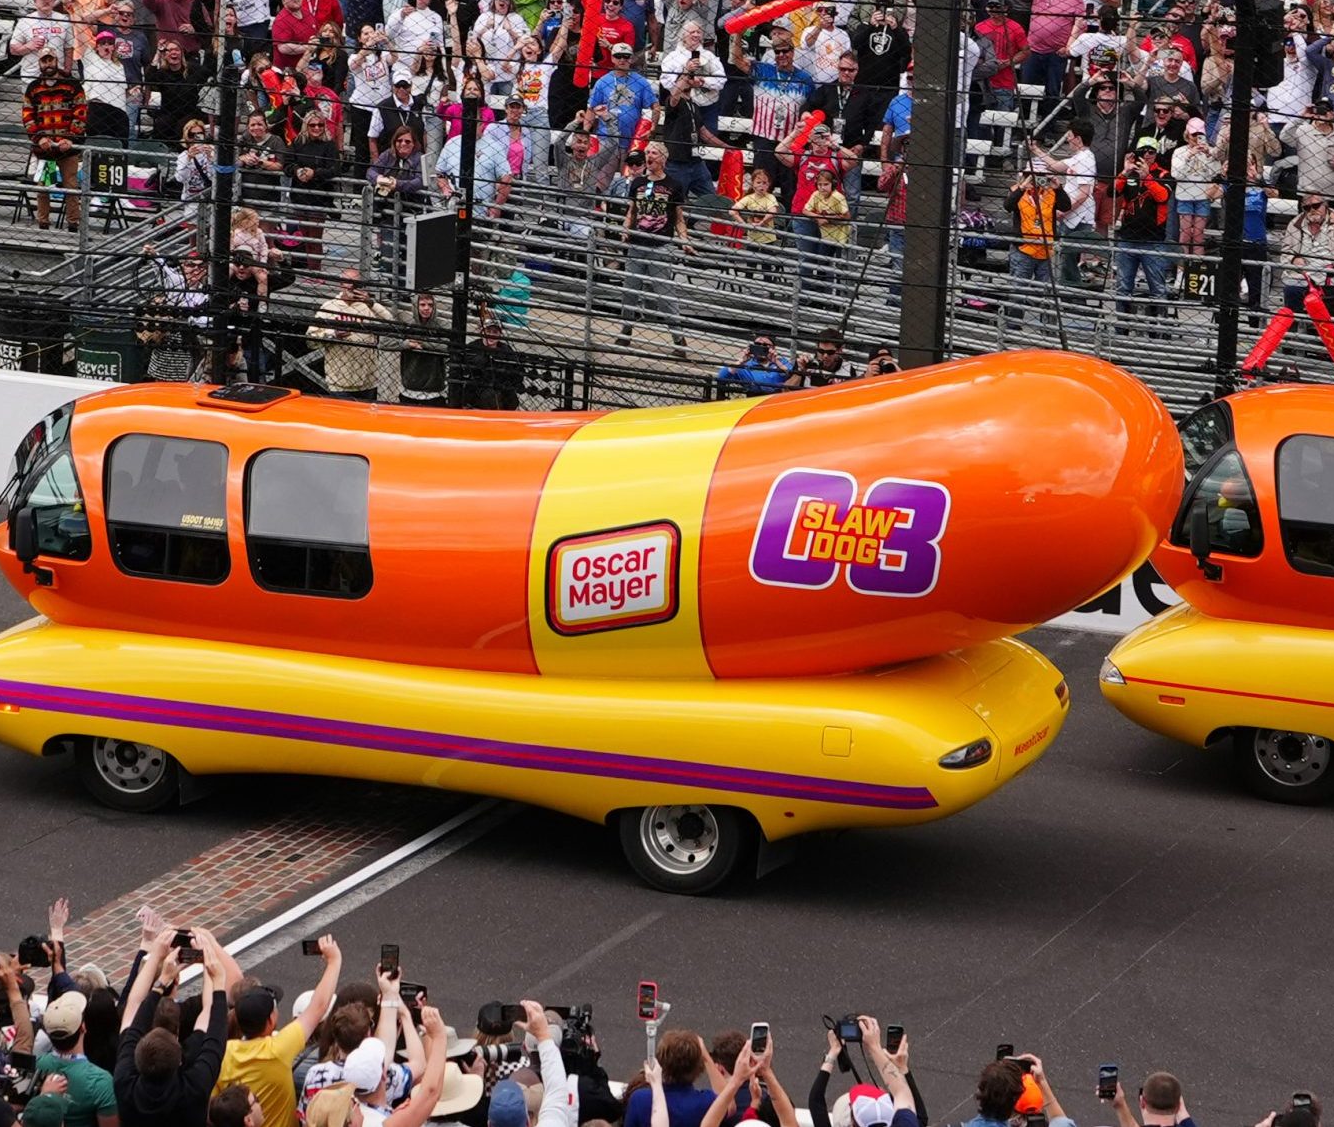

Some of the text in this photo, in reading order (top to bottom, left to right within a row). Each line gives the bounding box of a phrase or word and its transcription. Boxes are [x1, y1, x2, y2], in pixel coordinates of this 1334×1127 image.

[108, 165, 124, 186] 19
[1188, 273, 1215, 296] BOX 21
[801, 501, 897, 539] SLAW
[572, 545, 656, 581] Oscar
[810, 533, 880, 566] DOG
[568, 572, 657, 610] Mayer
